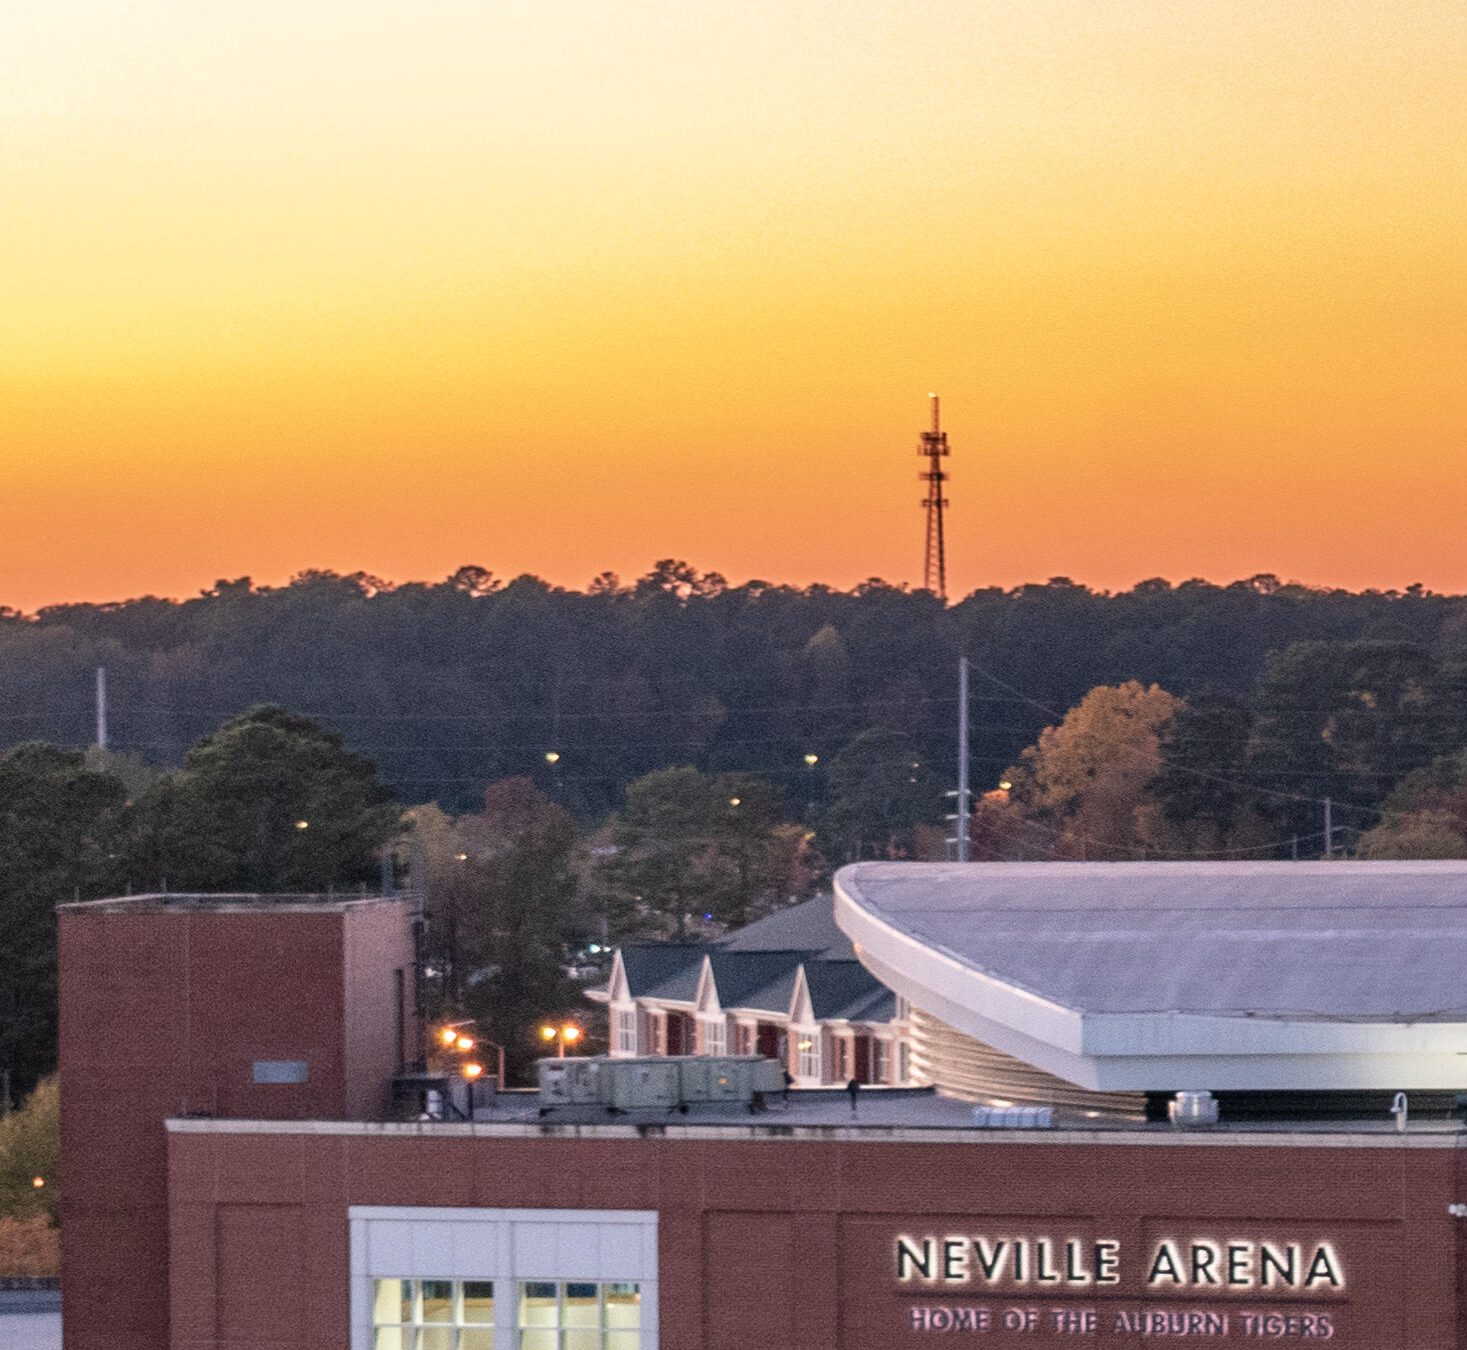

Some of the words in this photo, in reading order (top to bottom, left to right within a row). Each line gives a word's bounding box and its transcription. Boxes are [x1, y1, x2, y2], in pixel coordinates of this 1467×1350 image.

[898, 1237, 1120, 1284] NEVILLE
[1148, 1240, 1344, 1290] ARENA
[911, 1307, 989, 1331] HOME
[1004, 1308, 1039, 1332] OF
[1052, 1309, 1097, 1334] THE
[1115, 1310, 1229, 1336] AUBURN
[1239, 1311, 1335, 1339] TIGERS
